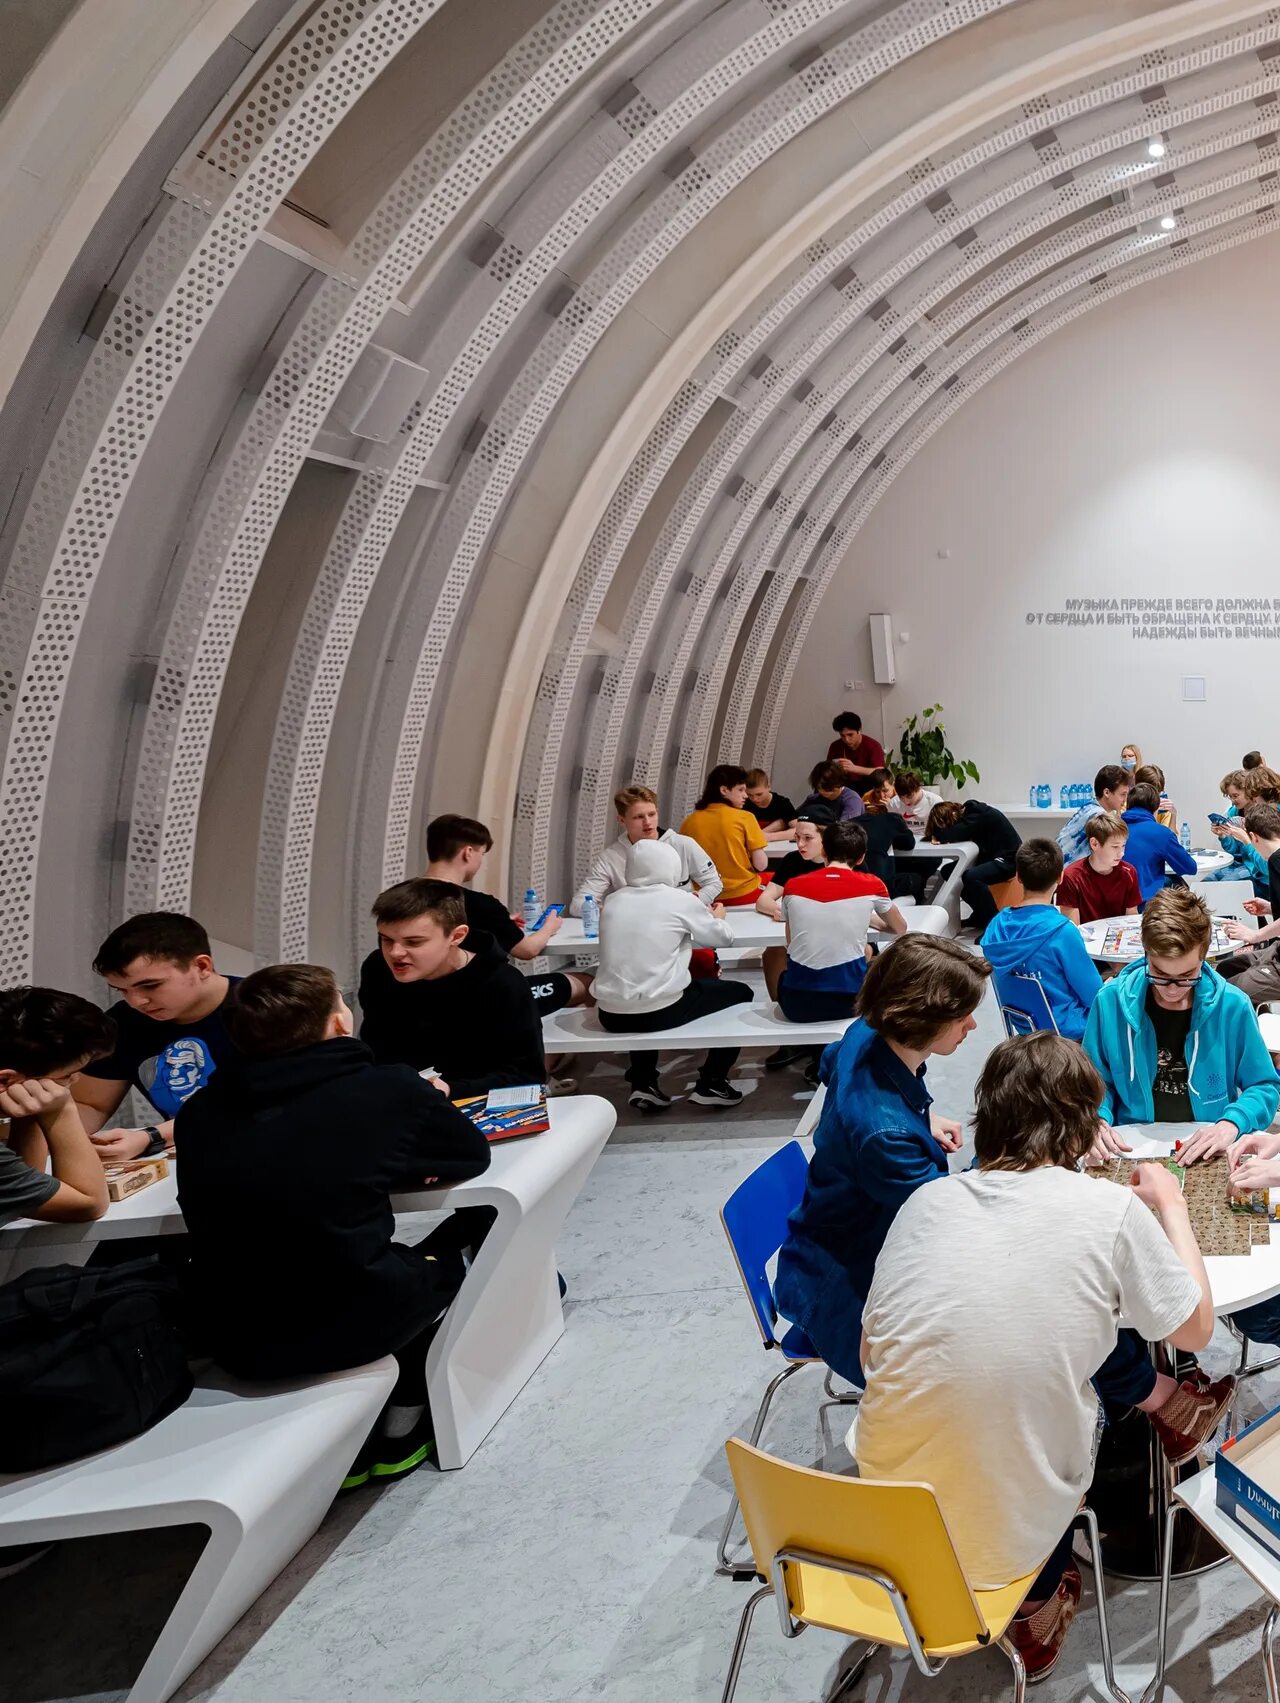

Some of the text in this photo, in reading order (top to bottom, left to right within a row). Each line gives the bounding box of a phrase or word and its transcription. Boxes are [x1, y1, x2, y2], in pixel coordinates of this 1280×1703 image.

[1065, 598, 1119, 611] МУЗЫКА
[1121, 598, 1173, 611] ПРЕЖДЕ
[1175, 598, 1213, 611] ВСЕГО
[1216, 598, 1271, 611] ДОЛЖНА
[1025, 613, 1043, 625] ОТ
[1045, 613, 1094, 625] СЕРДЦА
[1096, 613, 1105, 625] И
[1107, 613, 1140, 625] БЫТЬ
[1142, 613, 1211, 625] ОБРАЩЕНА
[1213, 613, 1221, 625] К
[1132, 627, 1197, 639] НАДЕЖДЫ
[1200, 627, 1232, 639] БЫТЬ
